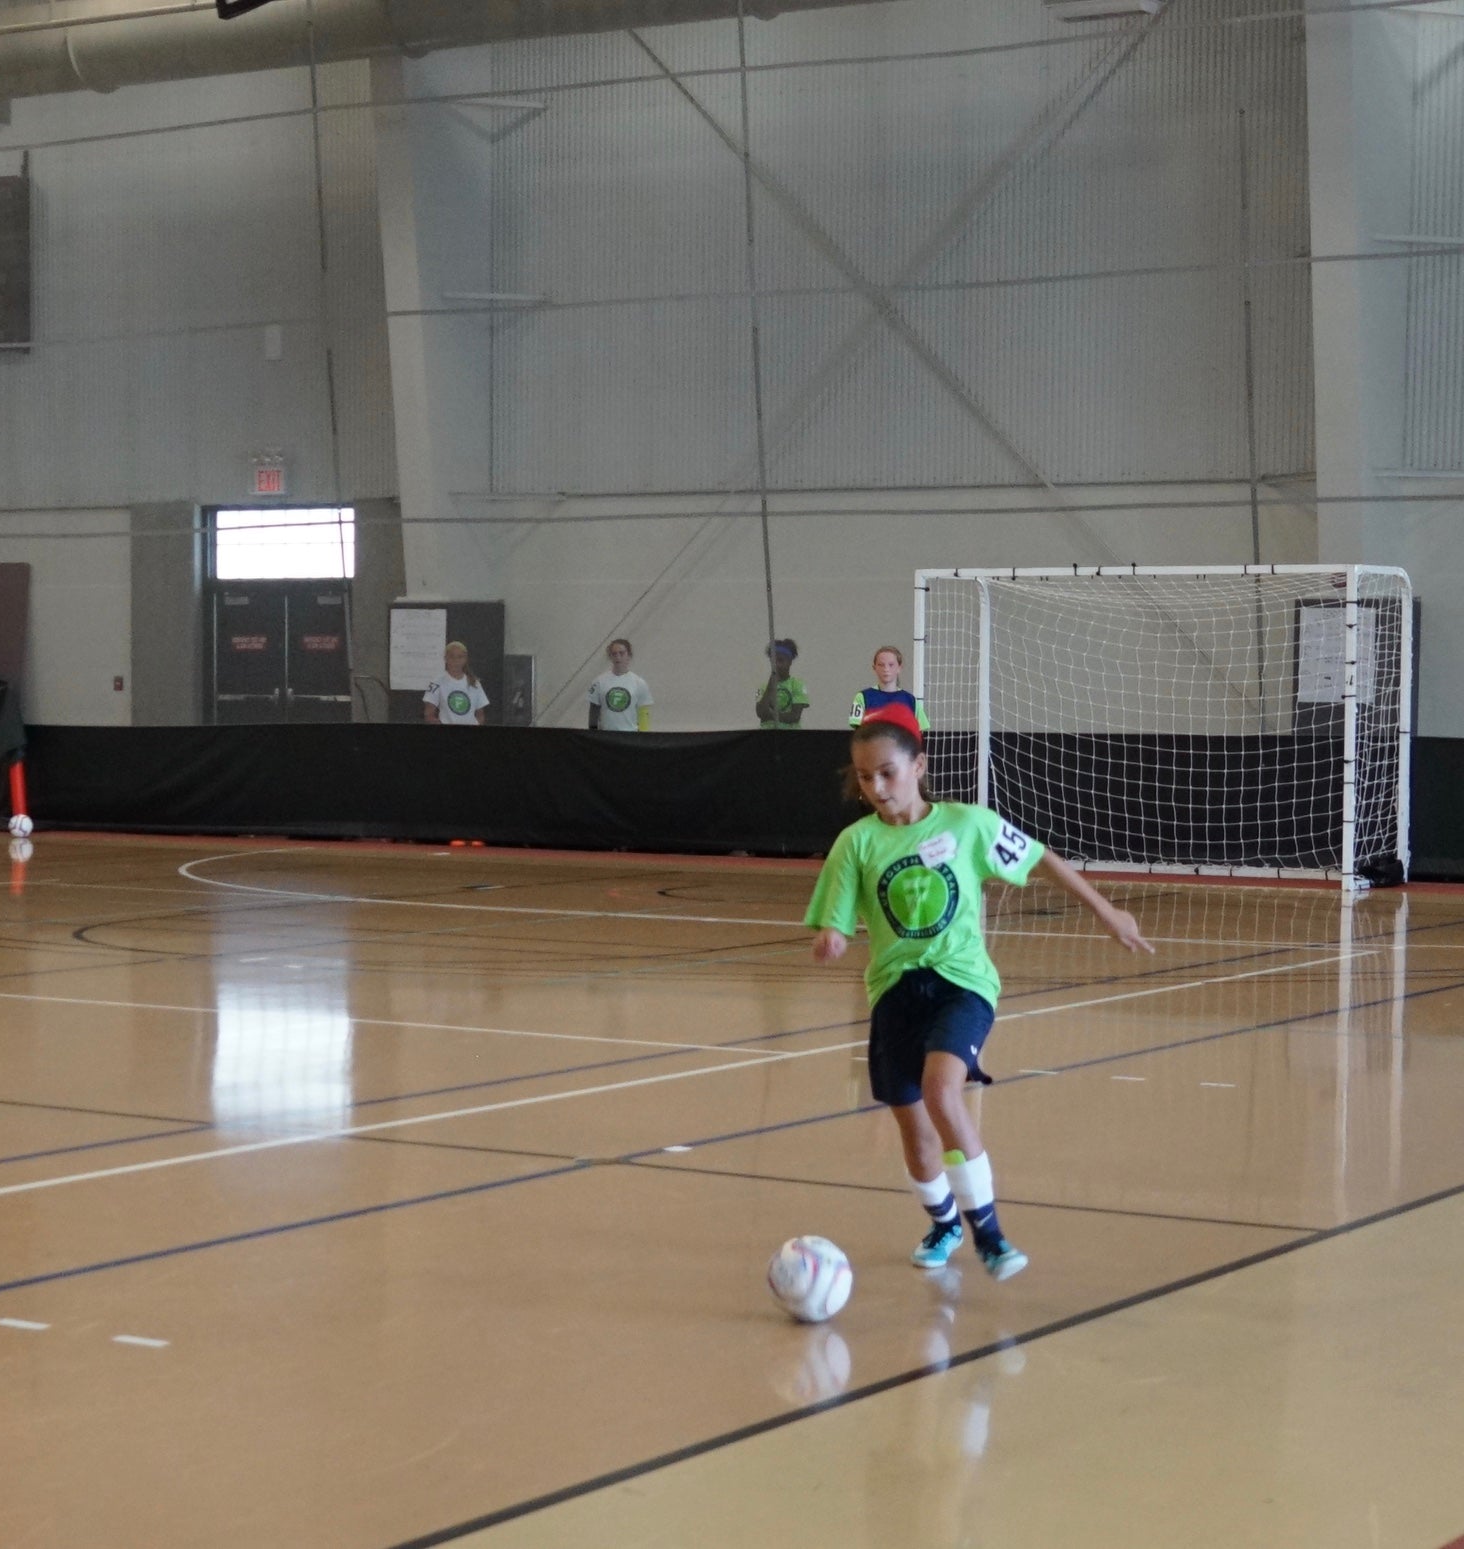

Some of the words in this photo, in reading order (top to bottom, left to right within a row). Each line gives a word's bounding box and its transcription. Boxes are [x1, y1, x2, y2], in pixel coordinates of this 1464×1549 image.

[257, 469, 281, 491] EXIT
[994, 824, 1027, 867] 45
[881, 857, 920, 885] YOUTH
